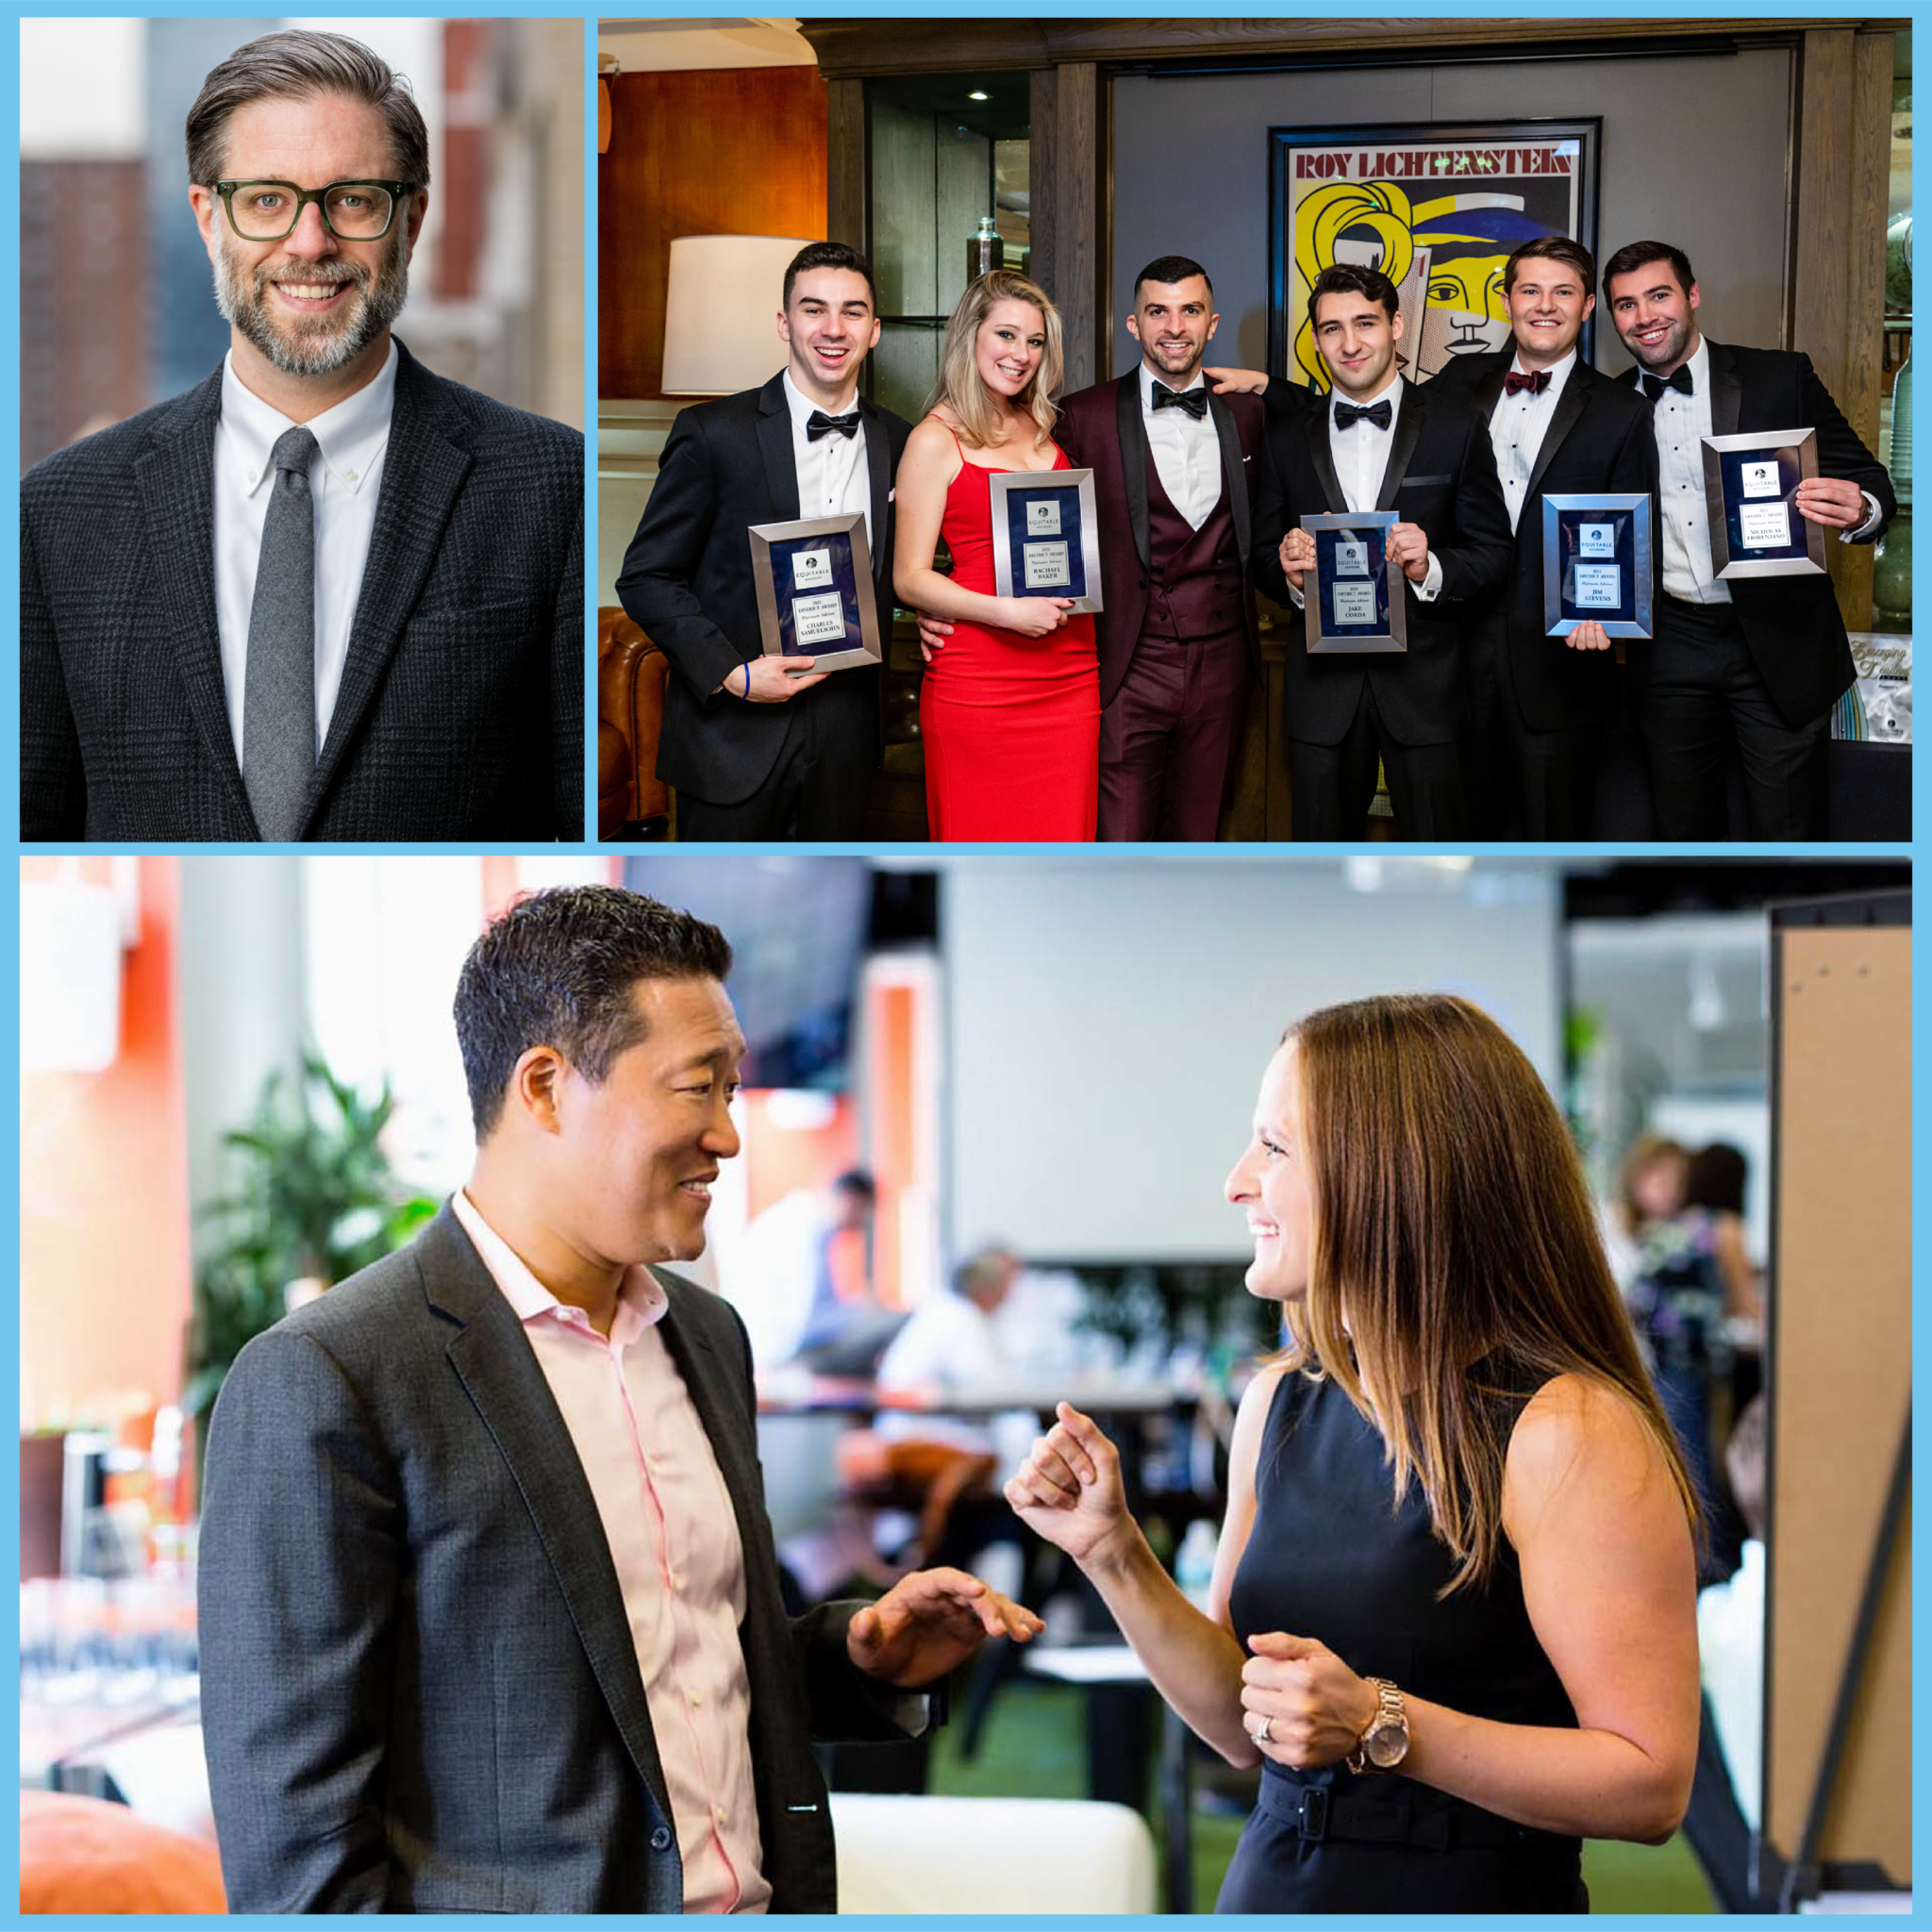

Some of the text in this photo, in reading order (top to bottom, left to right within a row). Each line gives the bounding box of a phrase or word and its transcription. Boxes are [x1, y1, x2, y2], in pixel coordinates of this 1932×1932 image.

[1296, 148, 1571, 178] ROY LICHTENSTEIN
[796, 569, 829, 578] EQUITABLE
[807, 620, 833, 629] CHARLES
[801, 625, 840, 635] SAMUELSOHN
[1851, 640, 1907, 661] Emerging
